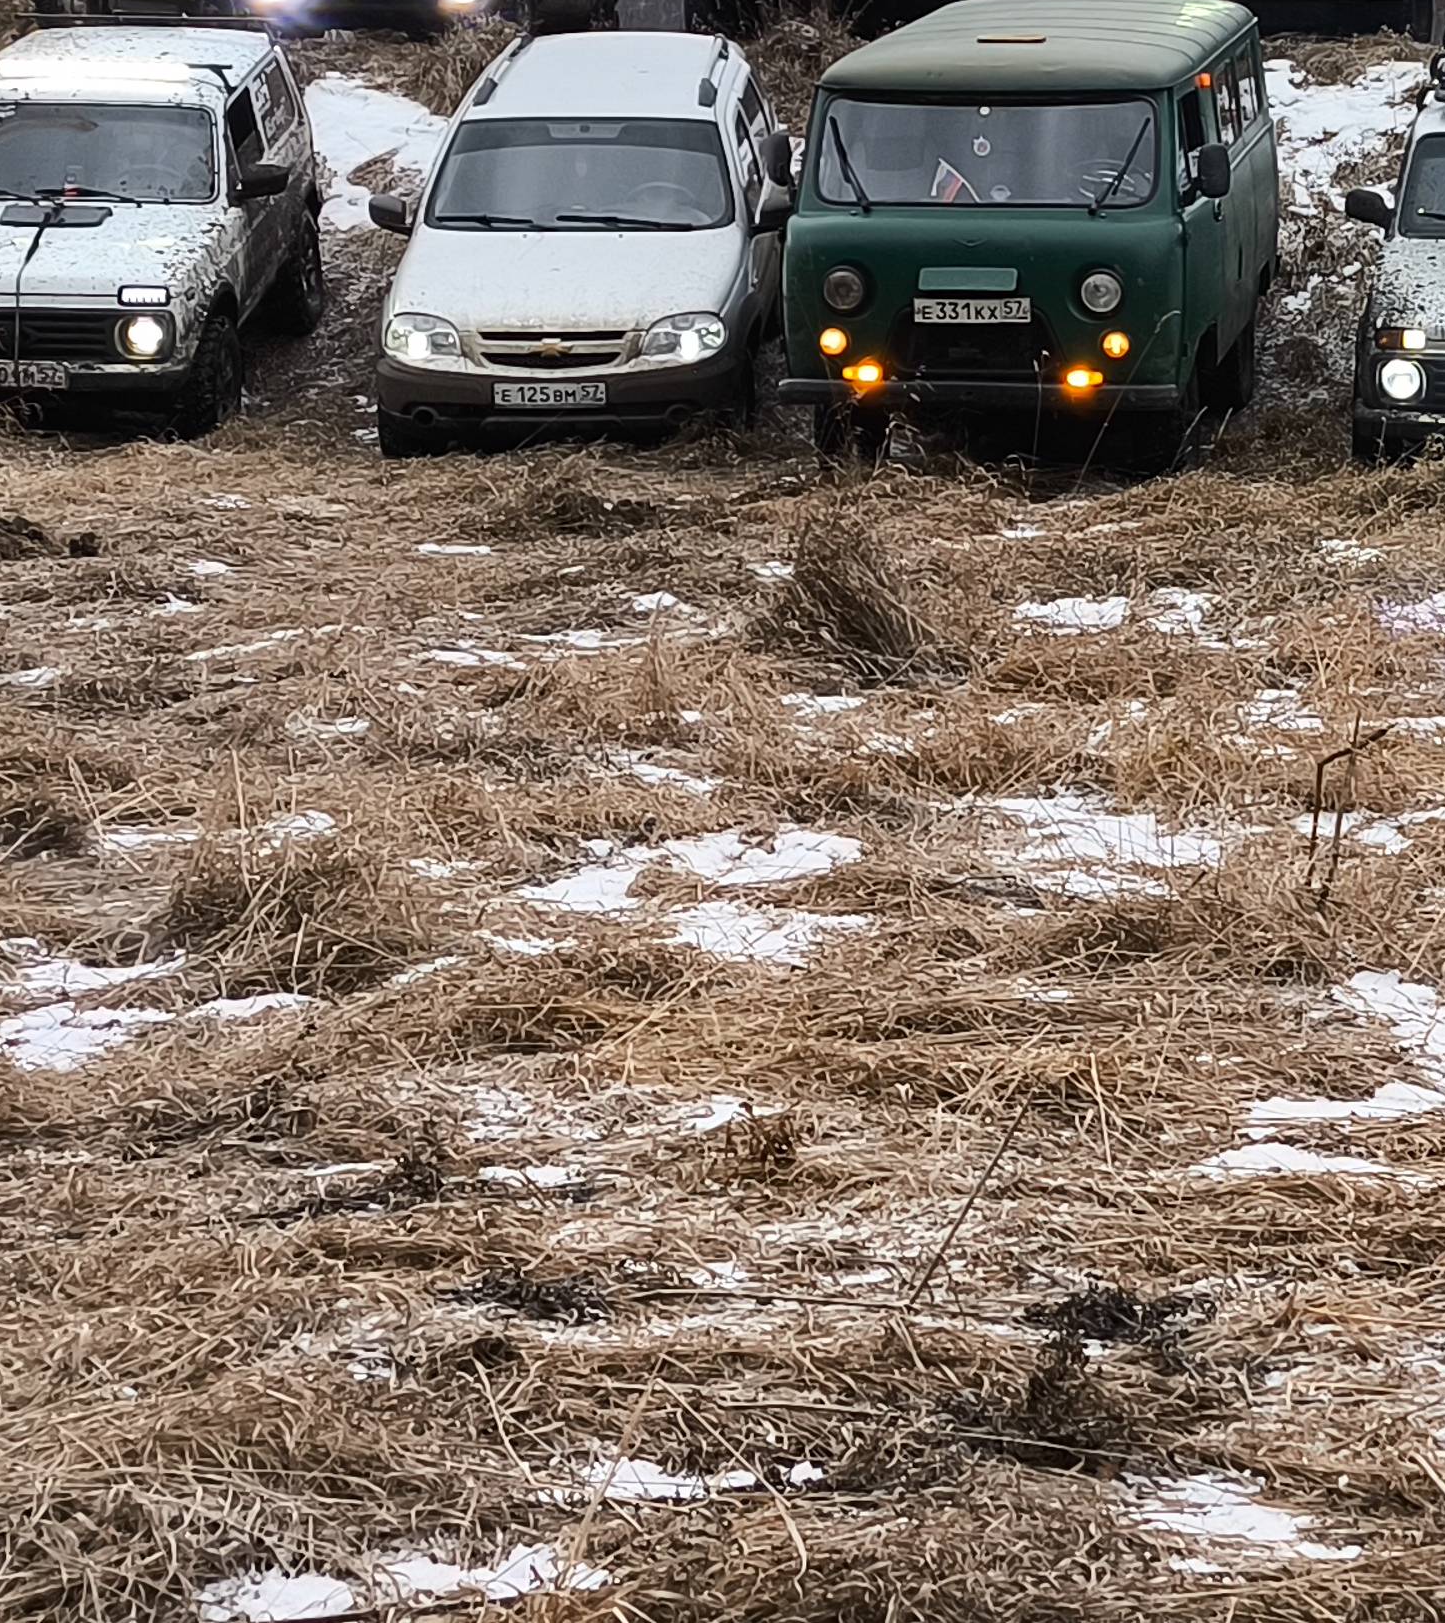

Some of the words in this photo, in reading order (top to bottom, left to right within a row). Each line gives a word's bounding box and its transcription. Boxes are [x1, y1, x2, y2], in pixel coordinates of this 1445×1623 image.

[922, 301, 999, 320] Е331КХ
[1003, 300, 1022, 315] 57
[501, 386, 577, 403] Е125ВМ
